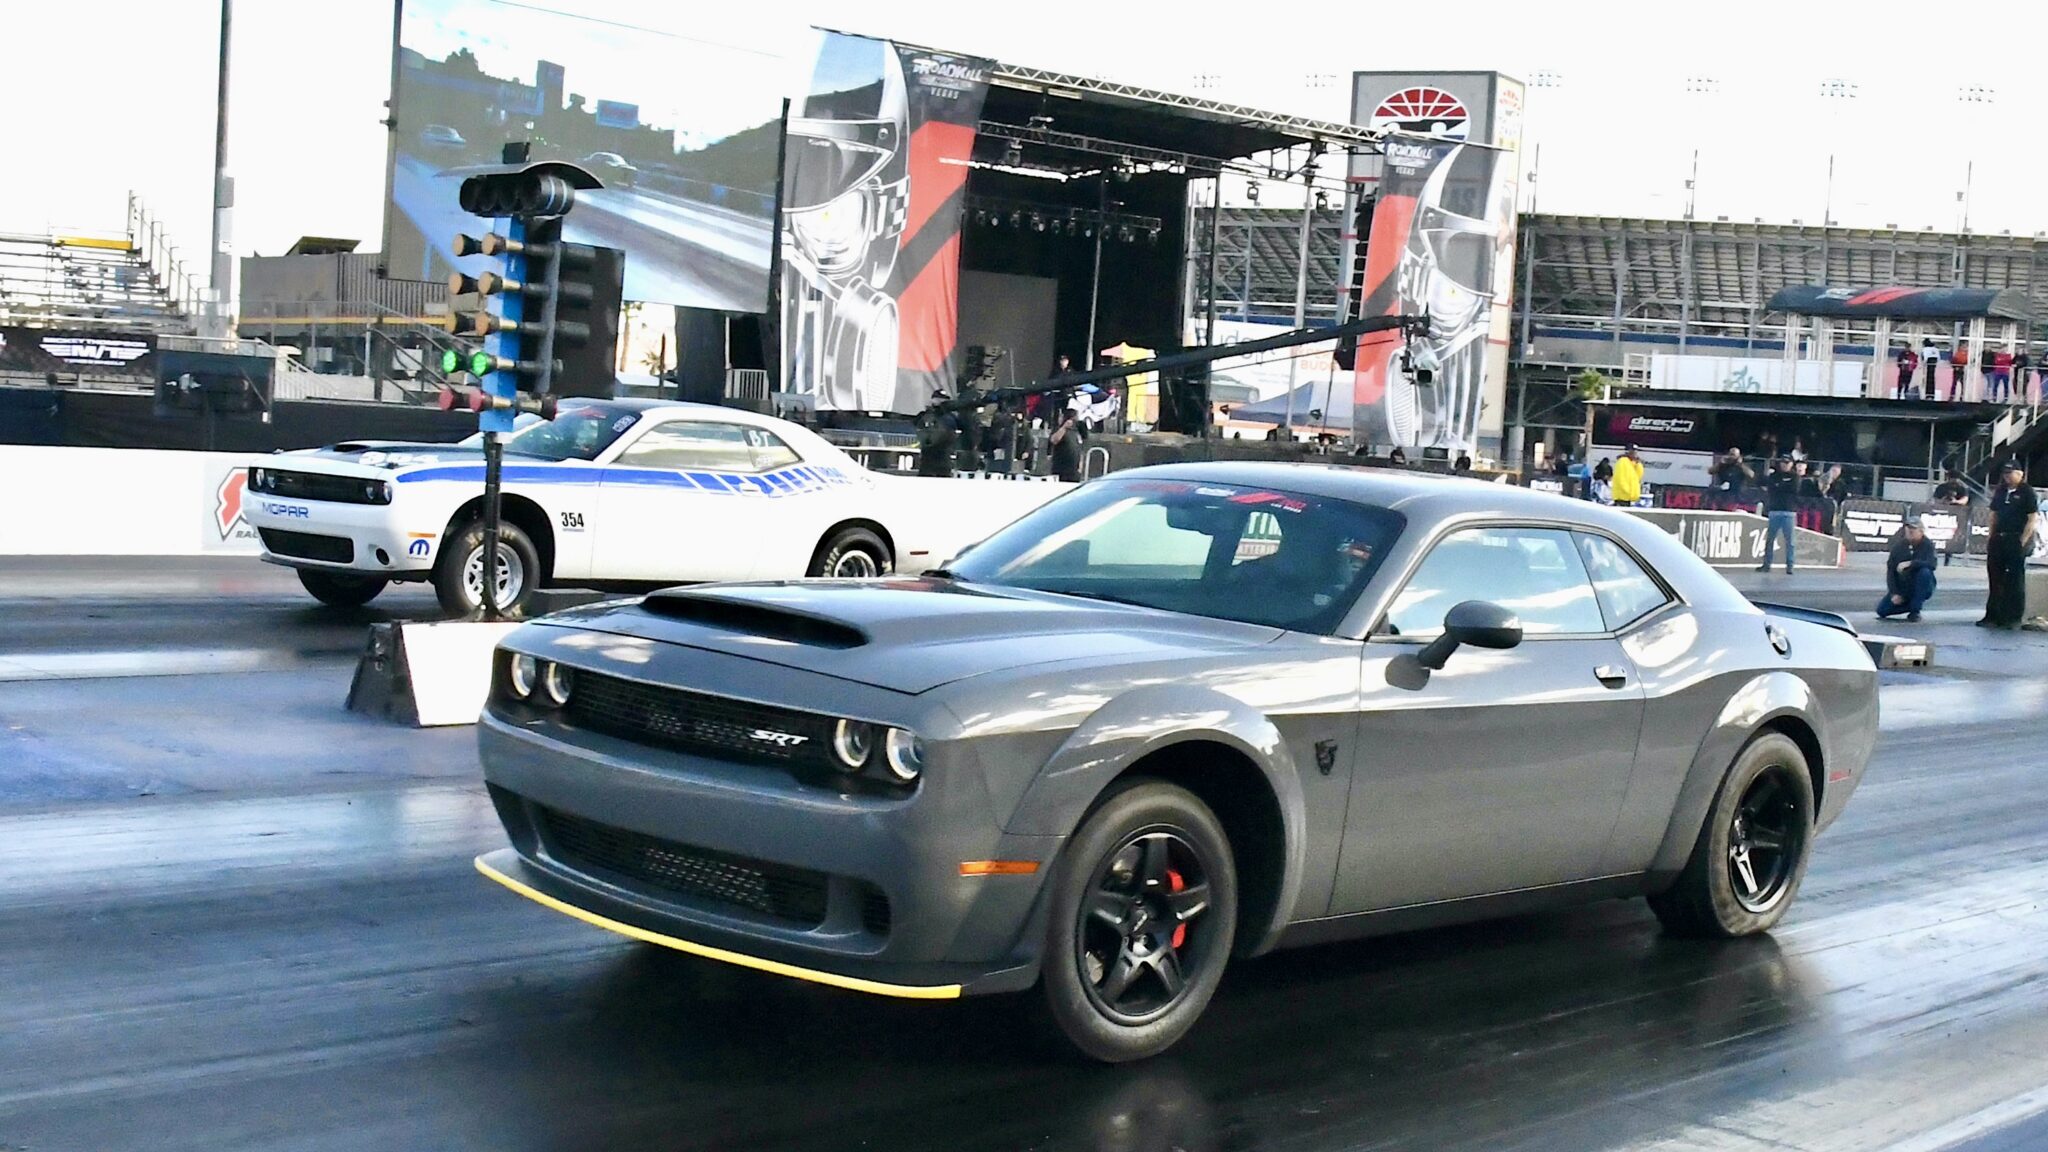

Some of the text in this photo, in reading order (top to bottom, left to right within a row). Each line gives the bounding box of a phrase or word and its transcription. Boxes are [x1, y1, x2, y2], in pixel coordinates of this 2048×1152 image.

[931, 87, 960, 100] VEGAS
[261, 501, 310, 519] MOPAR
[561, 512, 585, 528] 354
[1709, 520, 1743, 559] VEGAS
[749, 729, 809, 747] SRT
